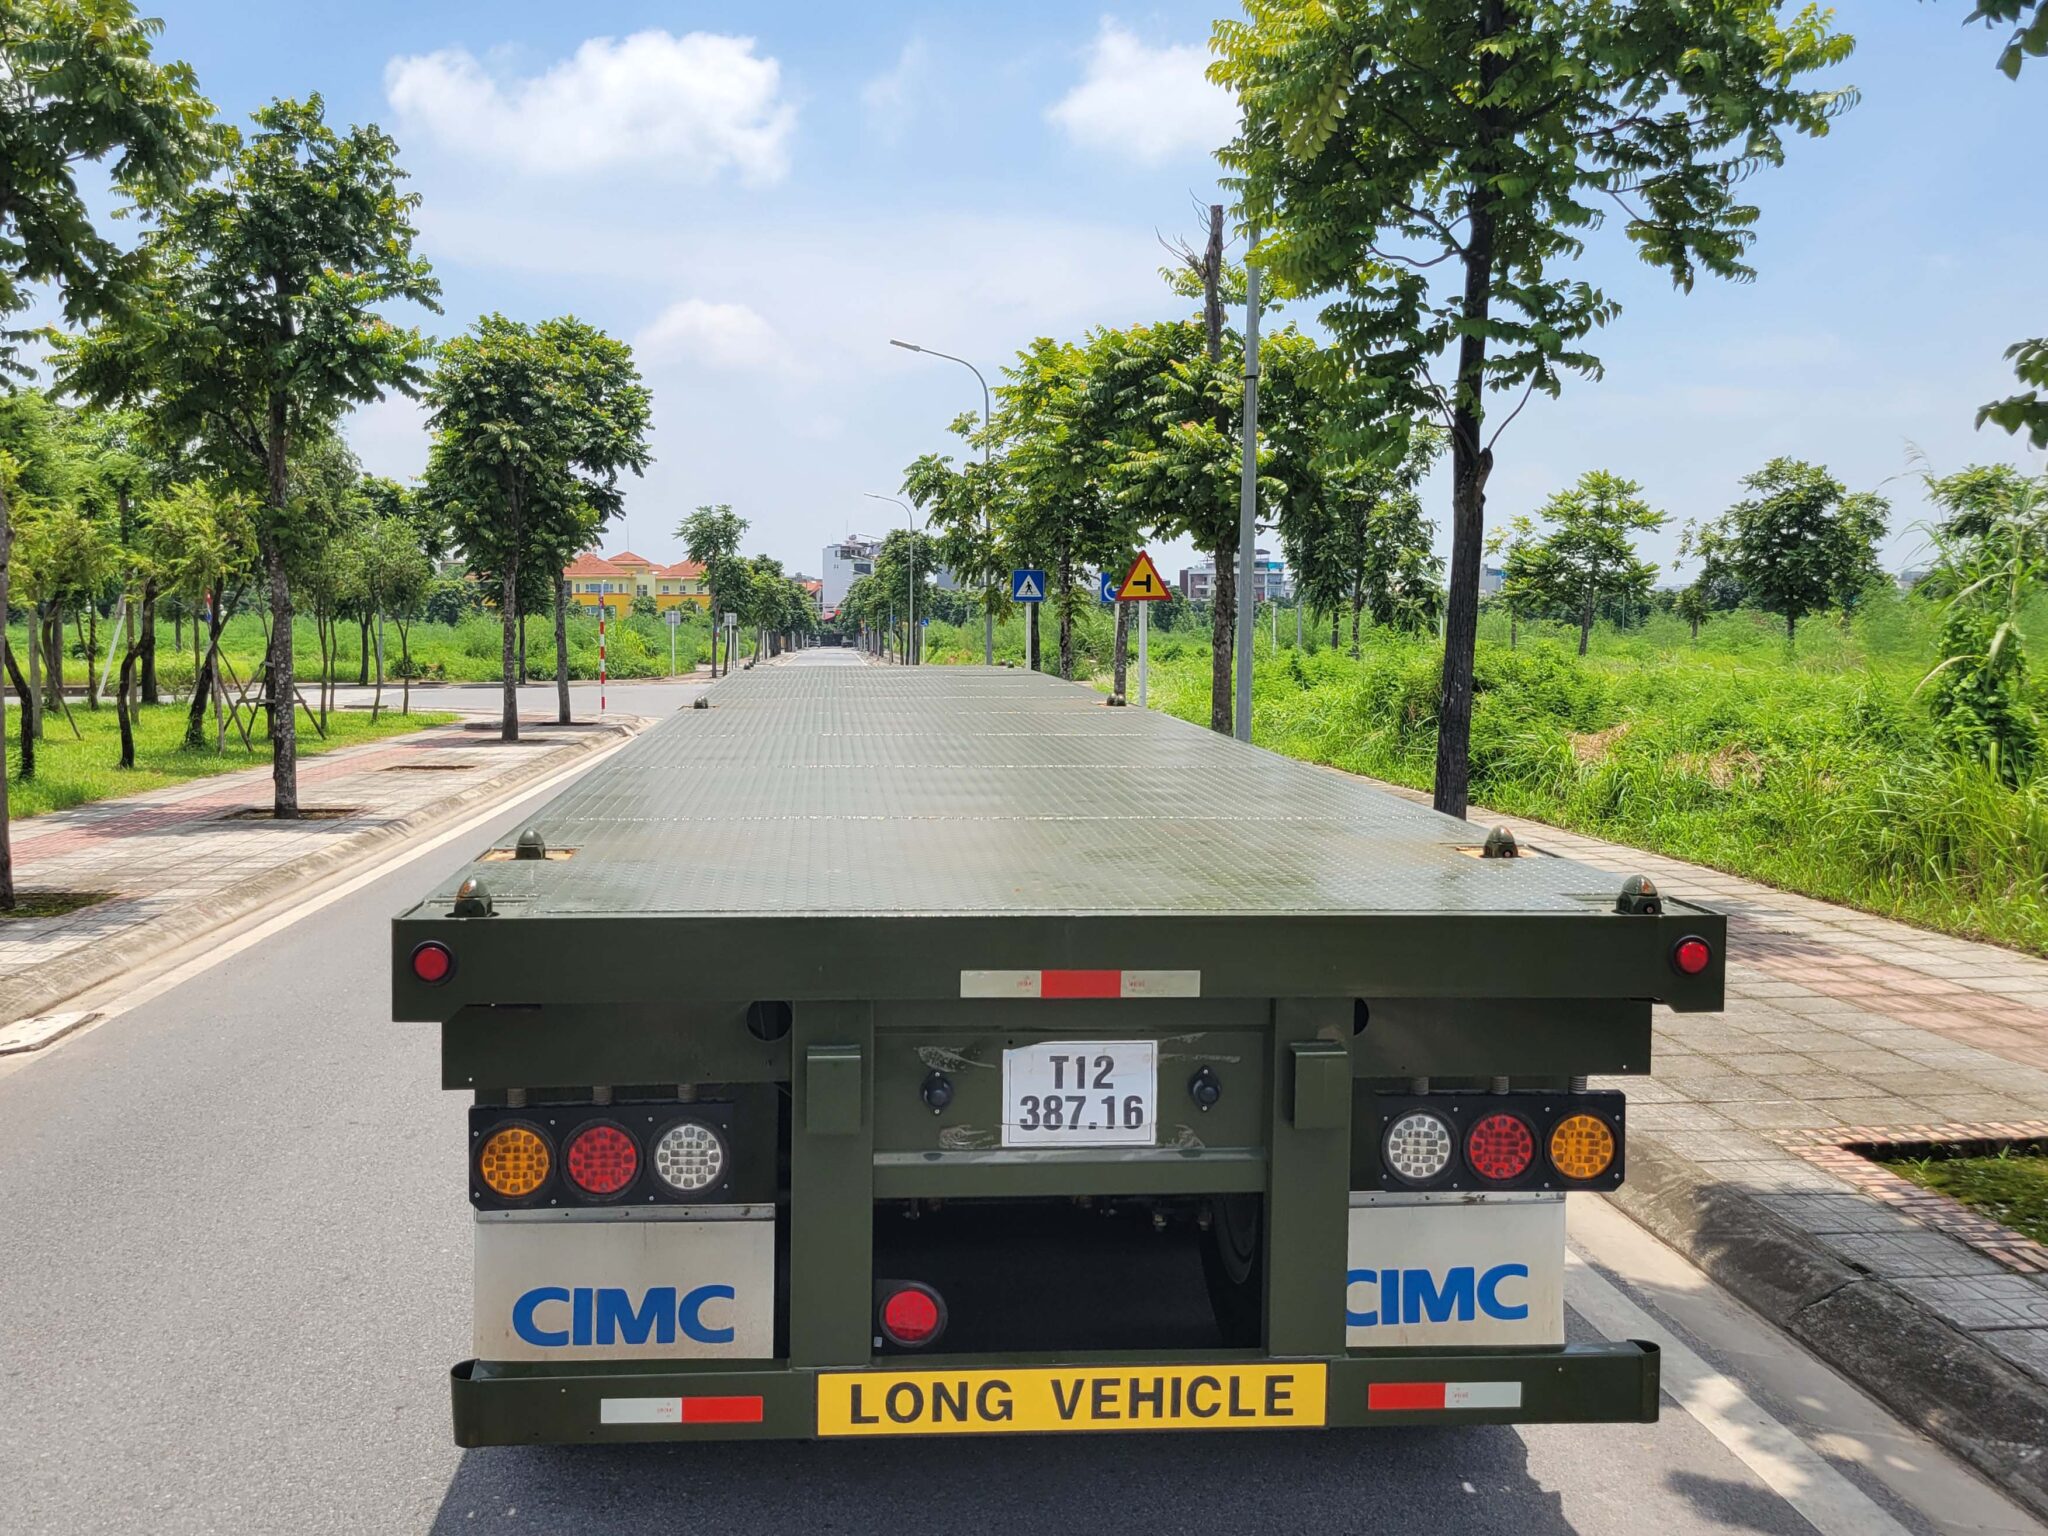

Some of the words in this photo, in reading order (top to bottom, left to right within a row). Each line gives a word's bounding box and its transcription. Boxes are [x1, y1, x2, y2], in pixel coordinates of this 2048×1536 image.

[1049, 1055, 1115, 1090] T12
[1019, 1094, 1144, 1131] 387.16
[512, 1284, 735, 1346] CIMC
[850, 1379, 1013, 1425] LONG
[1051, 1374, 1294, 1420] VEHICLE
